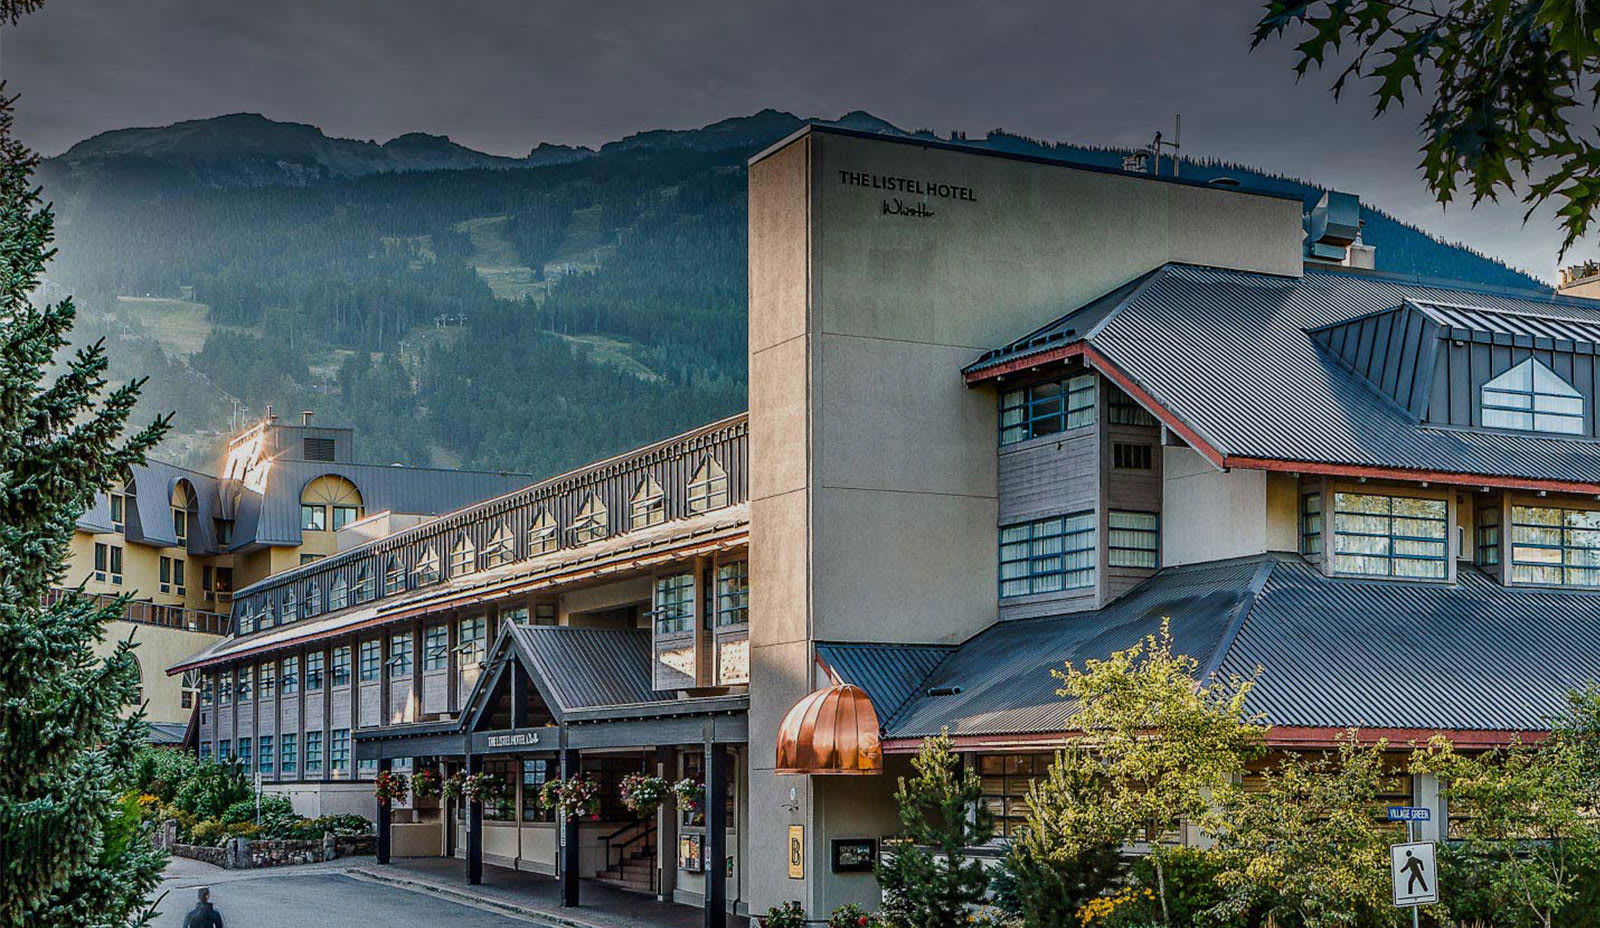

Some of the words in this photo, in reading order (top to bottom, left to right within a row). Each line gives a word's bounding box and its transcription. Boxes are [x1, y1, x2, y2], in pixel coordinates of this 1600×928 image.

[839, 170, 870, 187] THE
[873, 175, 923, 194] LISTEL
[926, 182, 977, 201] HOTEL
[488, 736, 497, 747] THE
[511, 734, 525, 745] HOTEL
[1389, 808, 1410, 819] VILLAGE
[1411, 809, 1429, 819] GREEN
